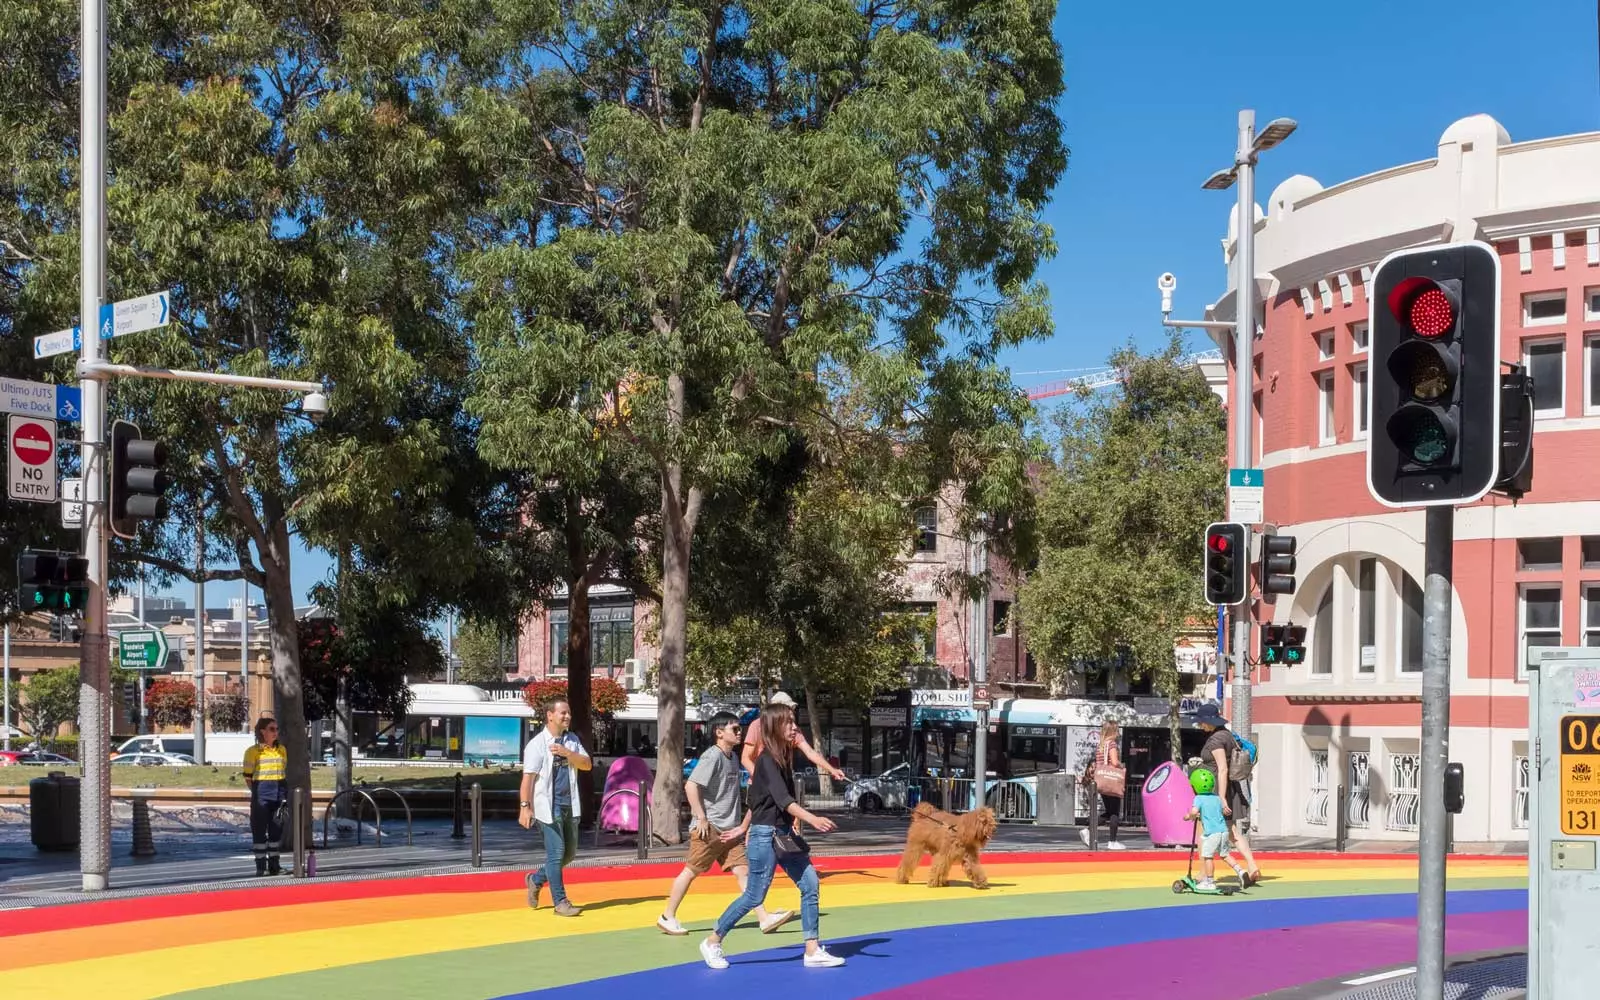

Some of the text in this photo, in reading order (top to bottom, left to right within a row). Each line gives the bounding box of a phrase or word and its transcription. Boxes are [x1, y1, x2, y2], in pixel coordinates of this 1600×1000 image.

[131, 303, 148, 314] Square
[116, 319, 133, 331] Airport
[1, 383, 30, 396] Ultimo
[11, 398, 52, 412] Five Dock
[22, 467, 43, 480] NO
[15, 482, 50, 496] ENTRY
[126, 651, 142, 659] Airport
[1567, 810, 1596, 830] 131
